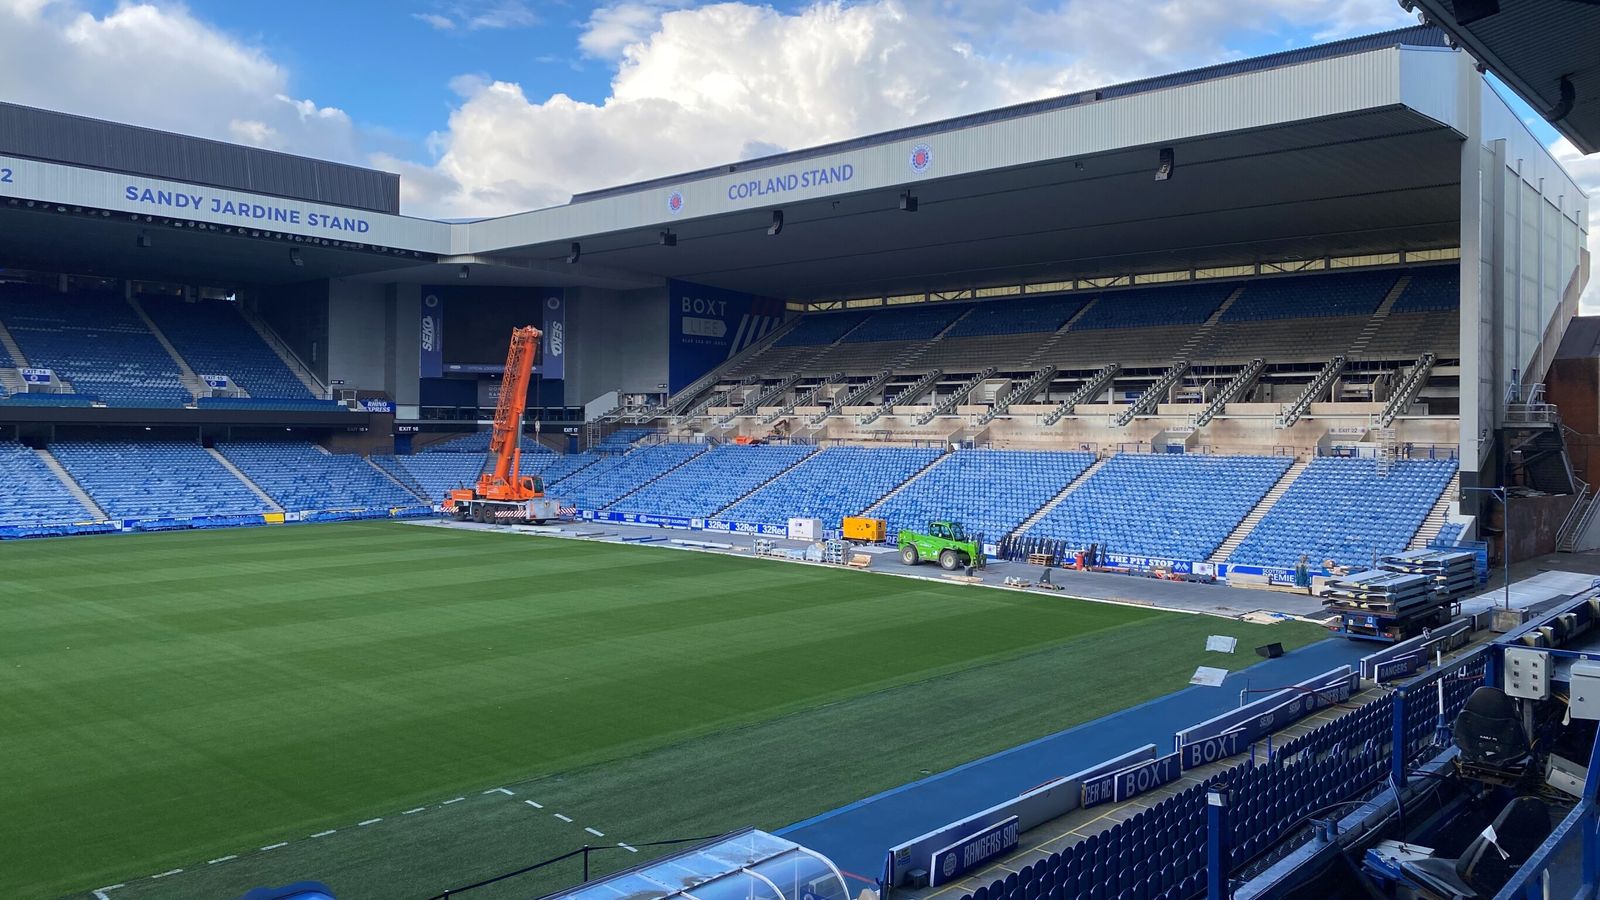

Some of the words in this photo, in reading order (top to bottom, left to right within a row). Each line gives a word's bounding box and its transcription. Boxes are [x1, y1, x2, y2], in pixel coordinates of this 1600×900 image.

[728, 174, 799, 201] COPLAND
[801, 163, 854, 188] STAND
[125, 185, 204, 210] SANDY
[211, 198, 300, 224] JARDINE
[307, 213, 369, 234] STAND
[682, 296, 727, 317] BOXT
[707, 520, 730, 530] 32Red
[735, 522, 758, 532] 32Red
[762, 524, 787, 535] 32Red
[1109, 555, 1129, 564] THE
[1130, 556, 1148, 566] PIT
[1149, 558, 1175, 568] STOP
[1192, 733, 1239, 767] BOXT
[1126, 757, 1172, 798] BOXT
[964, 830, 1001, 868] RANGERS
